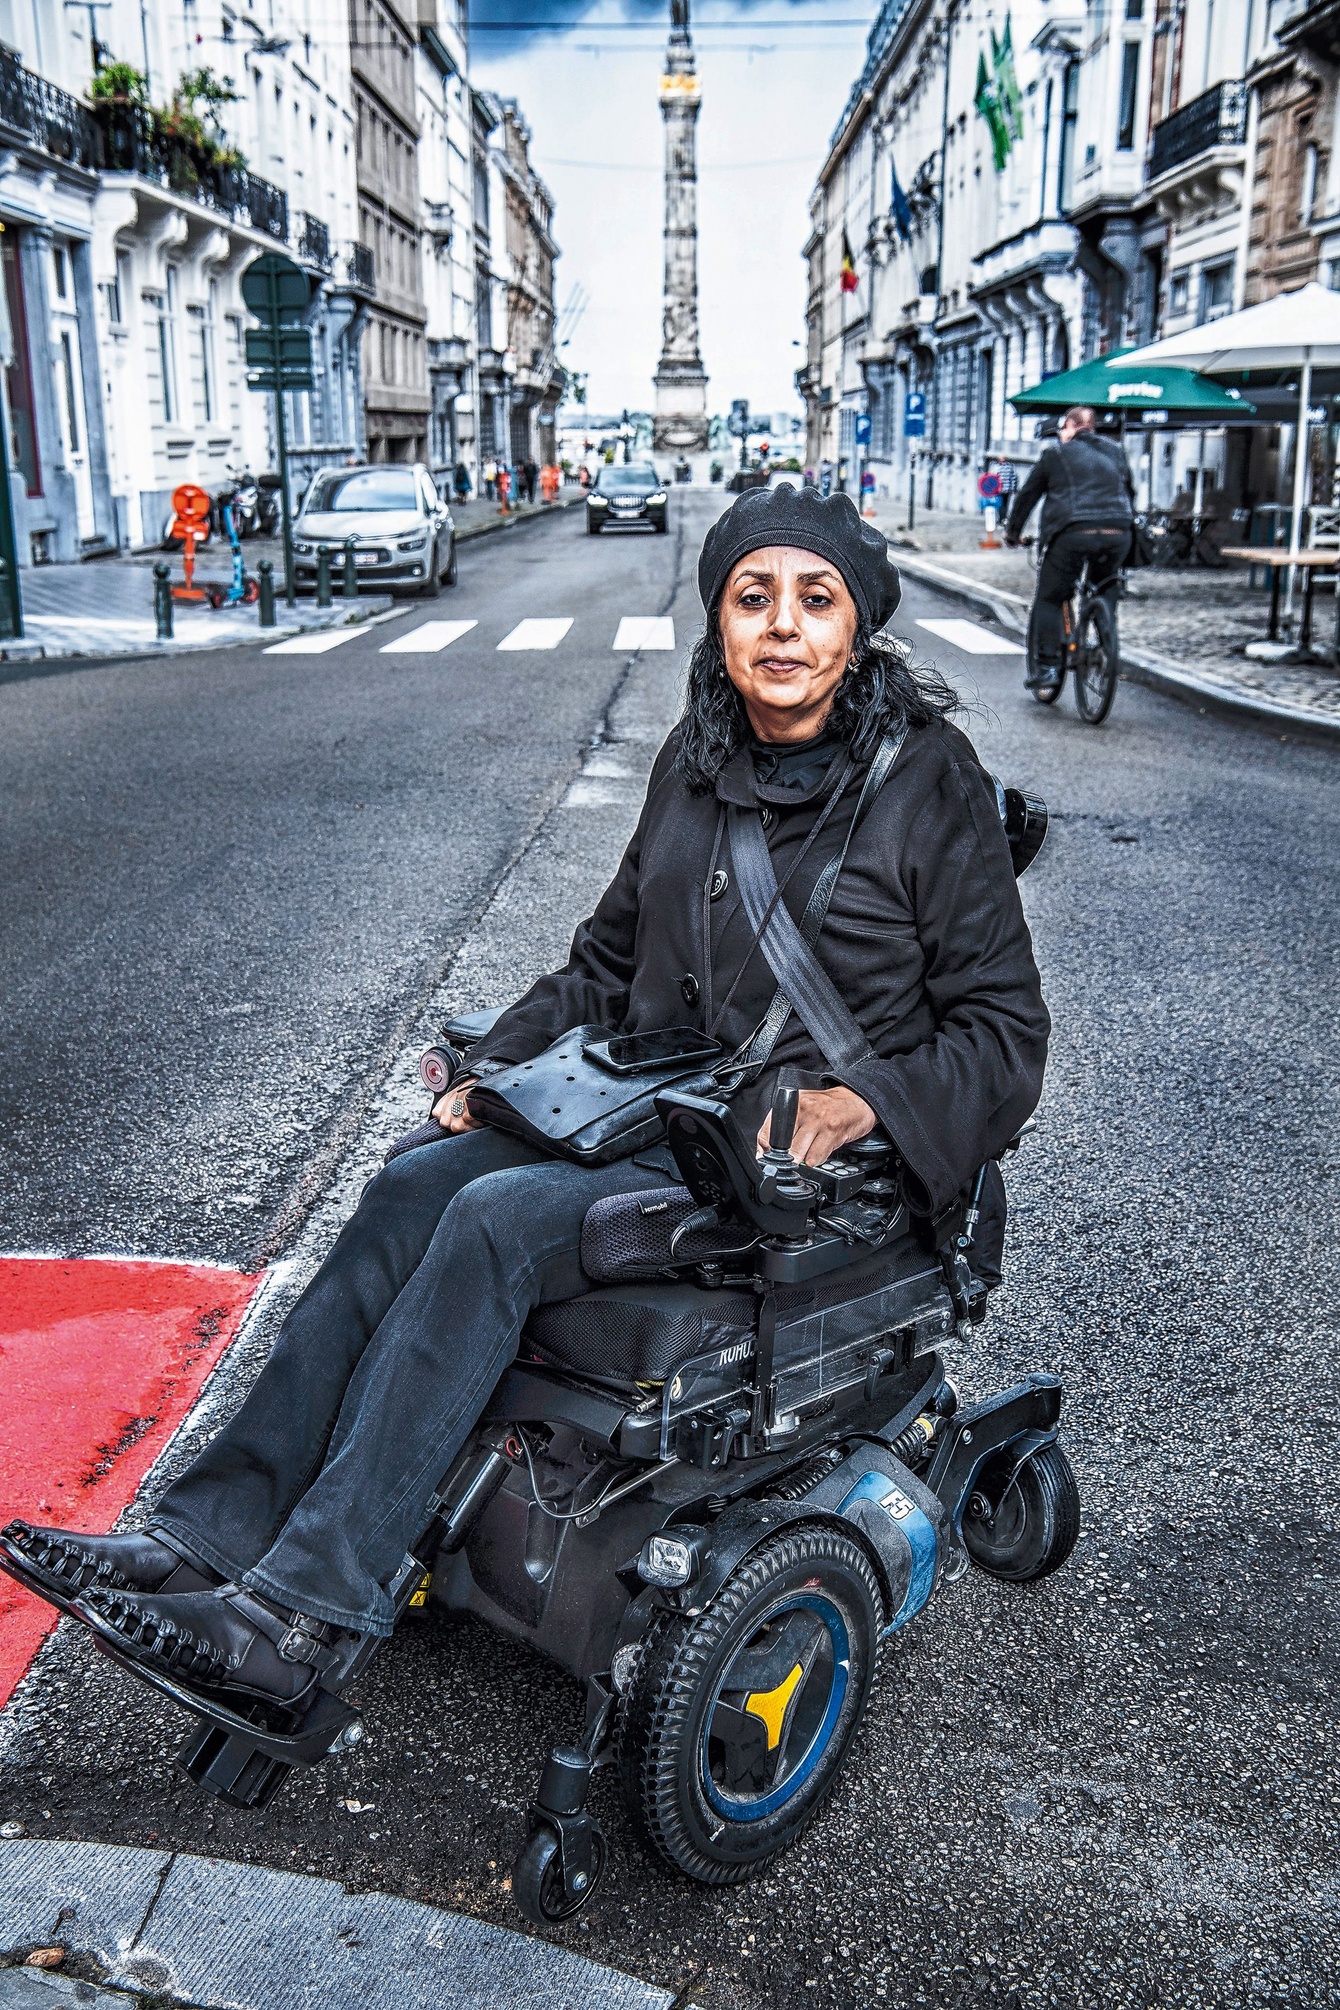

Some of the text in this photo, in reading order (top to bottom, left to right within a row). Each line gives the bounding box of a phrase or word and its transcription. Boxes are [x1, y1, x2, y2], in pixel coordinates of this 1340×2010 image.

[909, 394, 921, 412] P
[857, 417, 871, 435] P
[879, 1488, 916, 1520] F5
